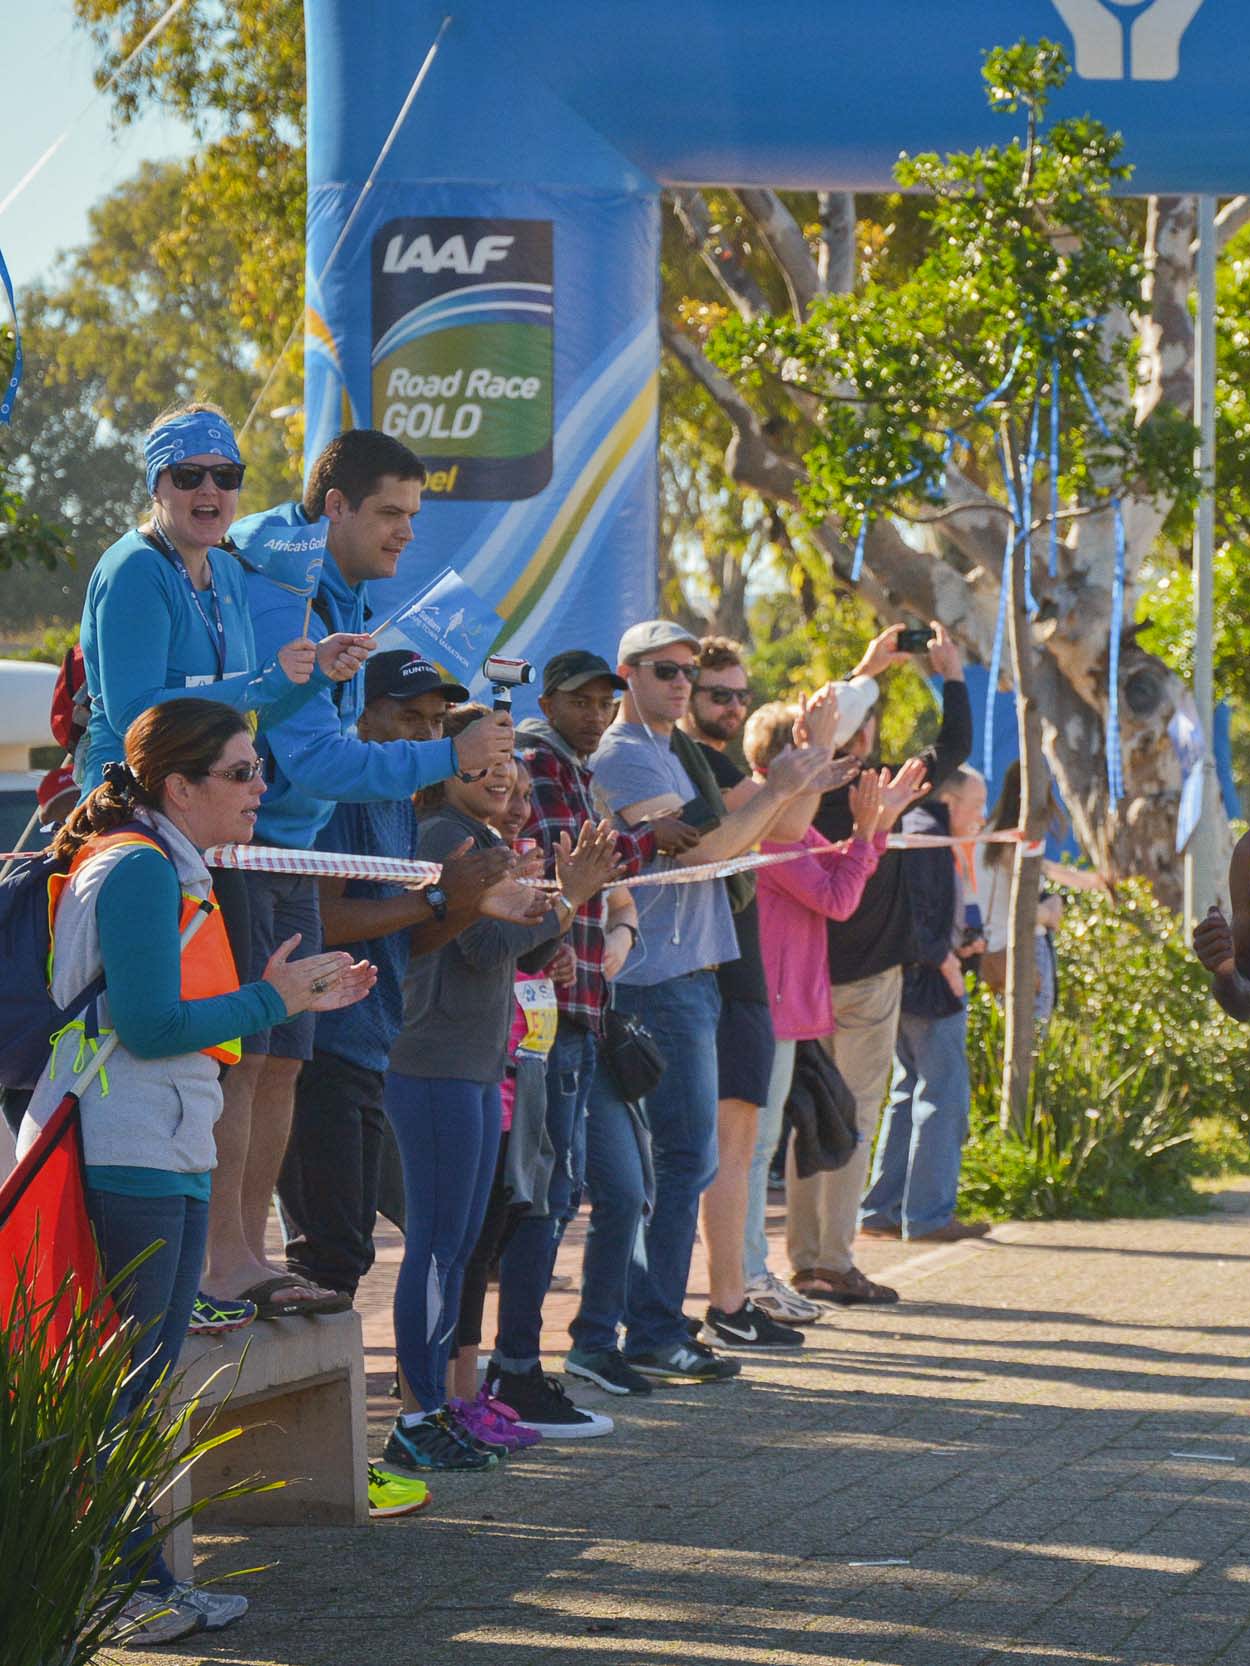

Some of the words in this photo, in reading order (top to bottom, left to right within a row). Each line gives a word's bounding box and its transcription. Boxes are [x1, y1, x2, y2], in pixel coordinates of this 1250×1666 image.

[382, 233, 515, 274] IAAF
[386, 366, 464, 399] Road
[464, 367, 541, 399] Race
[382, 402, 482, 440] GOLD
